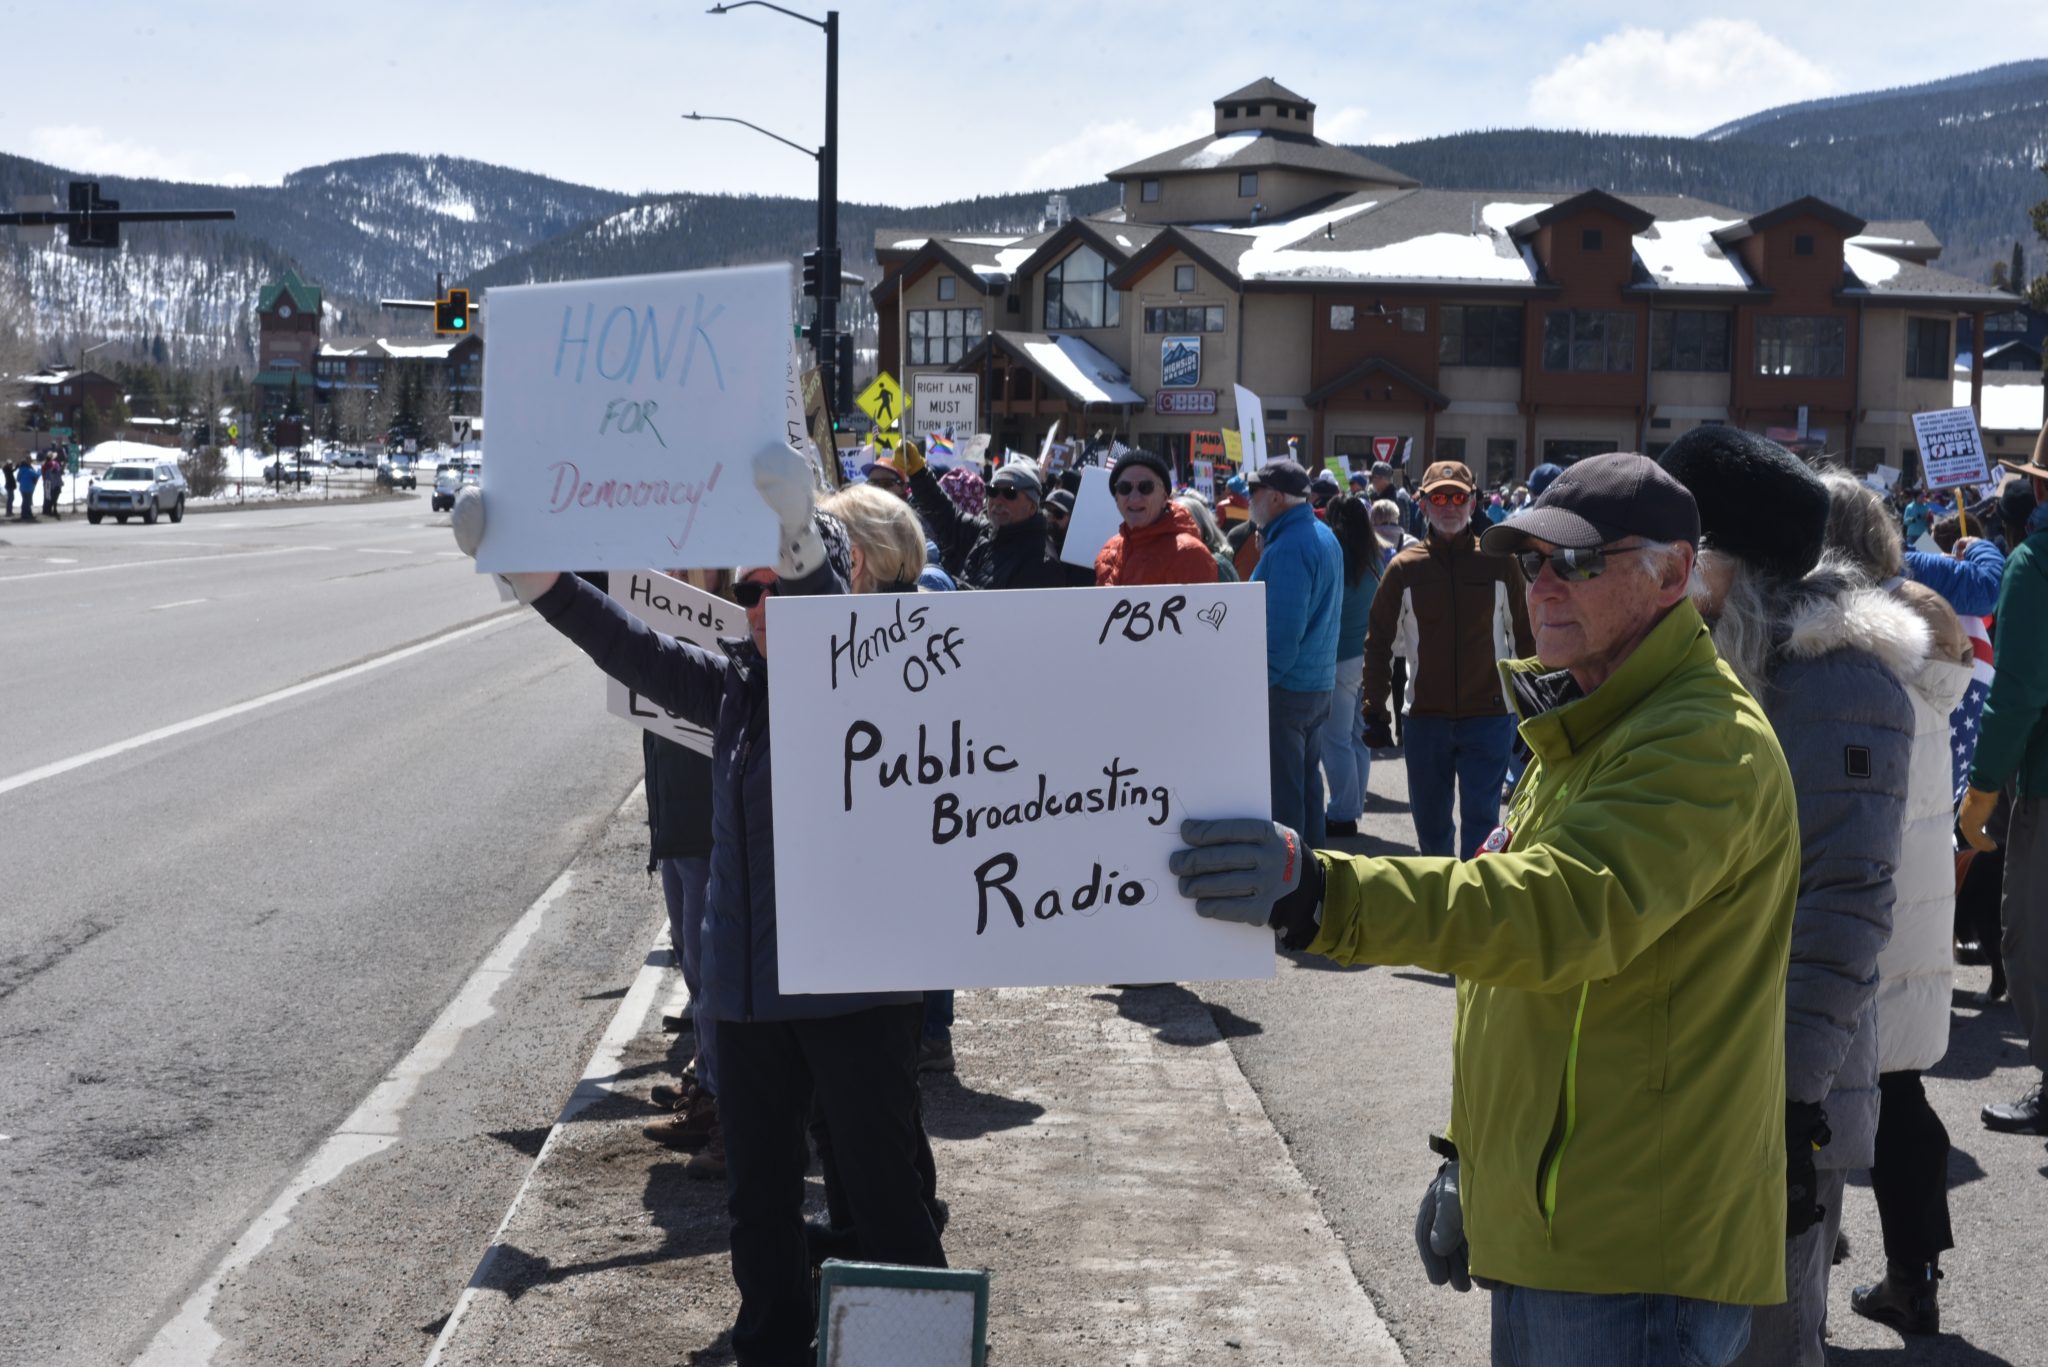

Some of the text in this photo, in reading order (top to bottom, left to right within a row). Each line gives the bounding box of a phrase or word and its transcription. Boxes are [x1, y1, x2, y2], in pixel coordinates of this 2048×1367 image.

[554, 292, 726, 392] HONK
[917, 382, 973, 394] RIGHT LANE
[930, 400, 960, 413] MUST
[600, 397, 667, 449] FOR
[917, 420, 972, 431] TURN RGHT
[1928, 431, 1970, 445] HANDS
[1930, 440, 1974, 458] OFF!
[546, 461, 724, 550] Democracy!
[630, 574, 725, 632] Hands
[831, 595, 1186, 690] Hands PBR
[844, 719, 1019, 812] Public
[932, 757, 1170, 845] Broadcasting
[973, 852, 1146, 936] Radio
